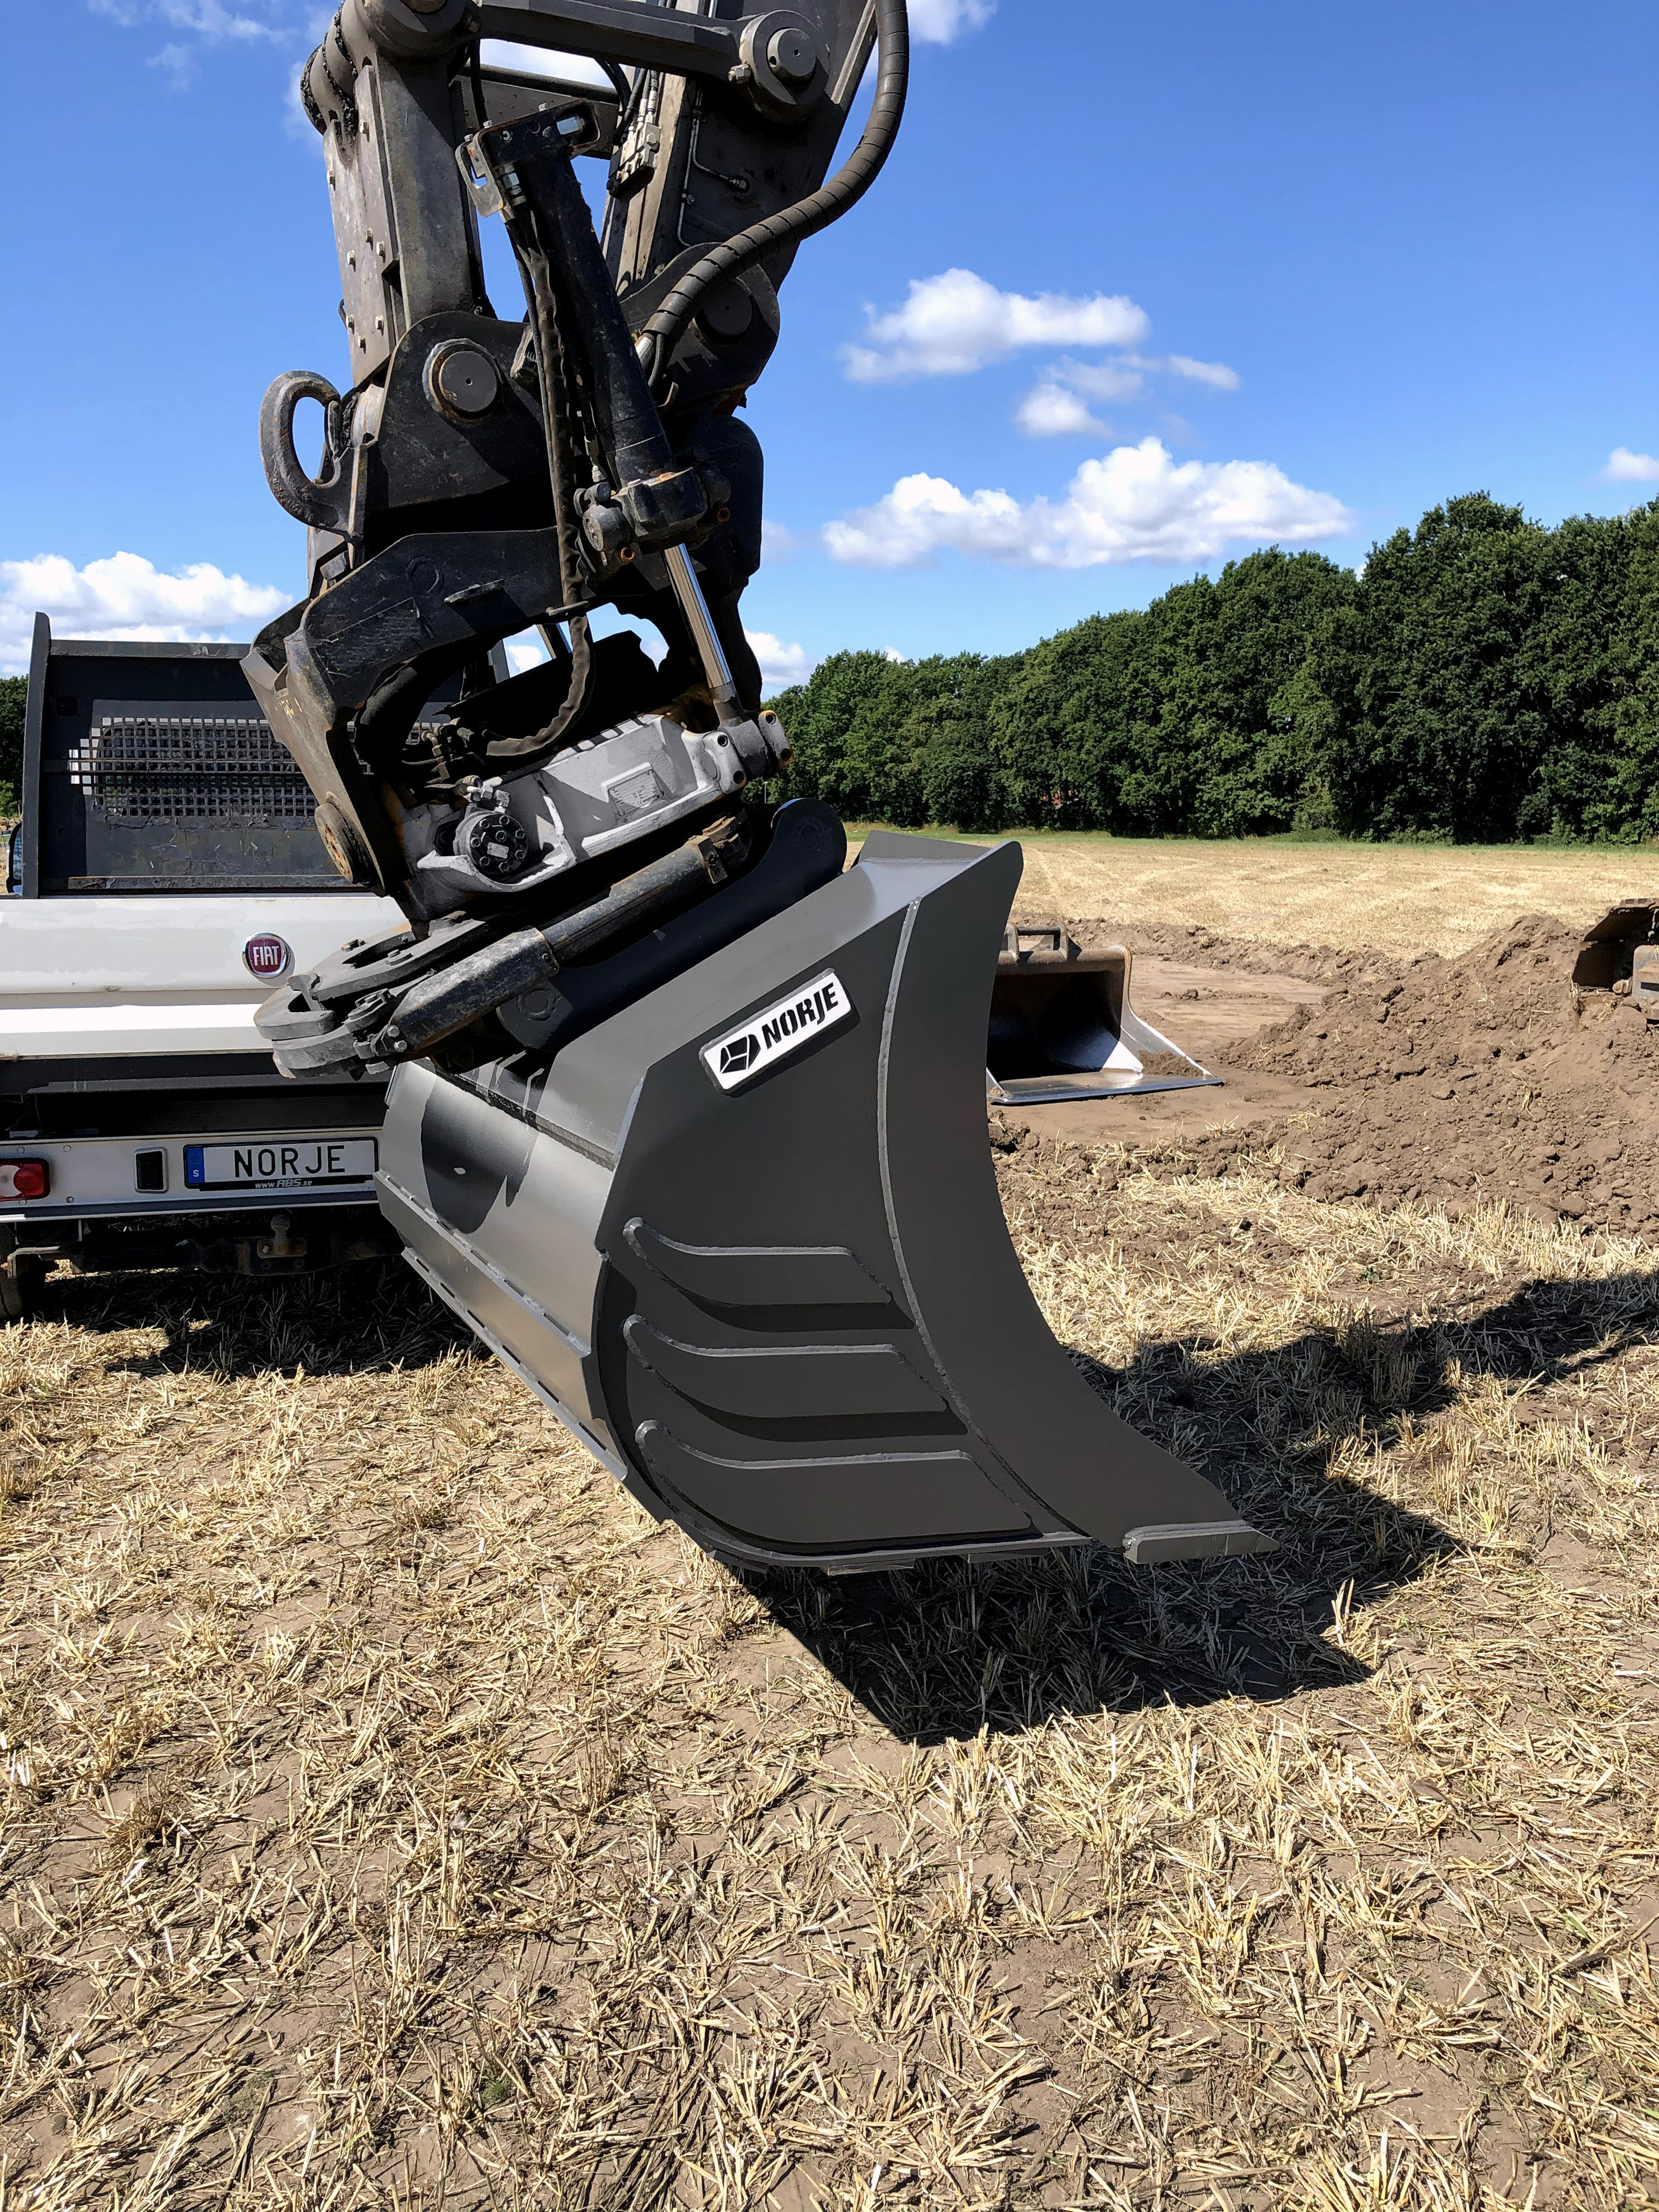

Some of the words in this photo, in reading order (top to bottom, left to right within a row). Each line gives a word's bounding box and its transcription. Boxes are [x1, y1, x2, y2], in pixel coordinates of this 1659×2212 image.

[253, 945, 279, 966] FIAT
[761, 982, 838, 1050] NORJE
[234, 1145, 345, 1178] NORJE
[192, 1169, 200, 1178] S
[255, 1179, 312, 1189] www.ABS.se
